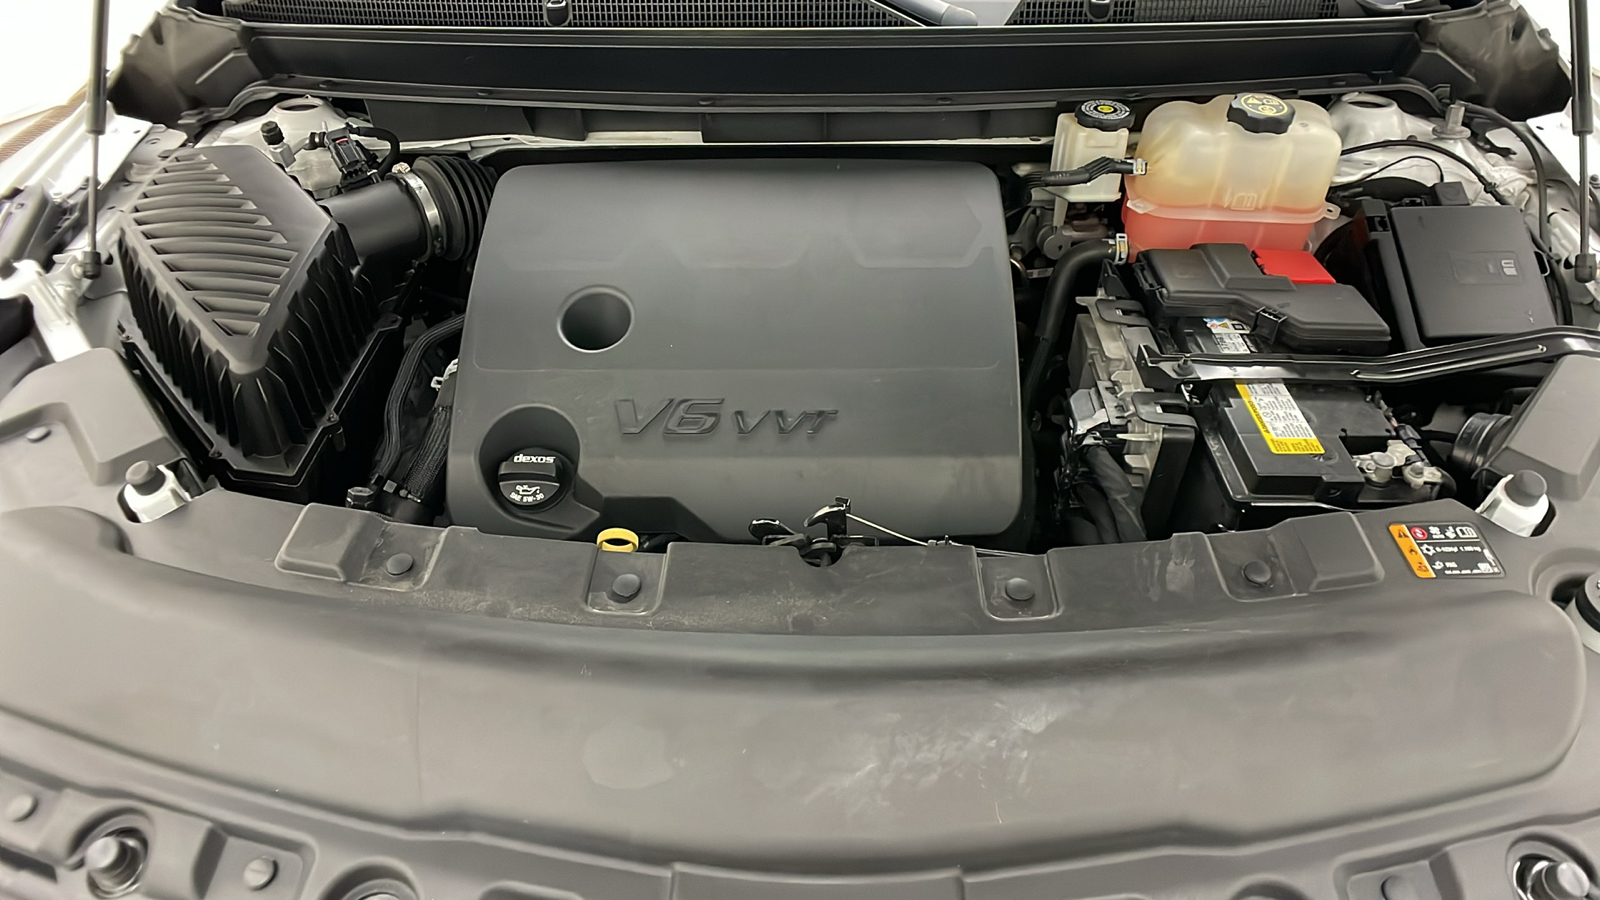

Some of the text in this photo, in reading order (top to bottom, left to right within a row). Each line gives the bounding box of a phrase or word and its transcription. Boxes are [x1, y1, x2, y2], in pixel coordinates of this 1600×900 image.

[615, 398, 839, 435] V6 VVT
[513, 453, 556, 464] dexos
[509, 491, 522, 502] SAE
